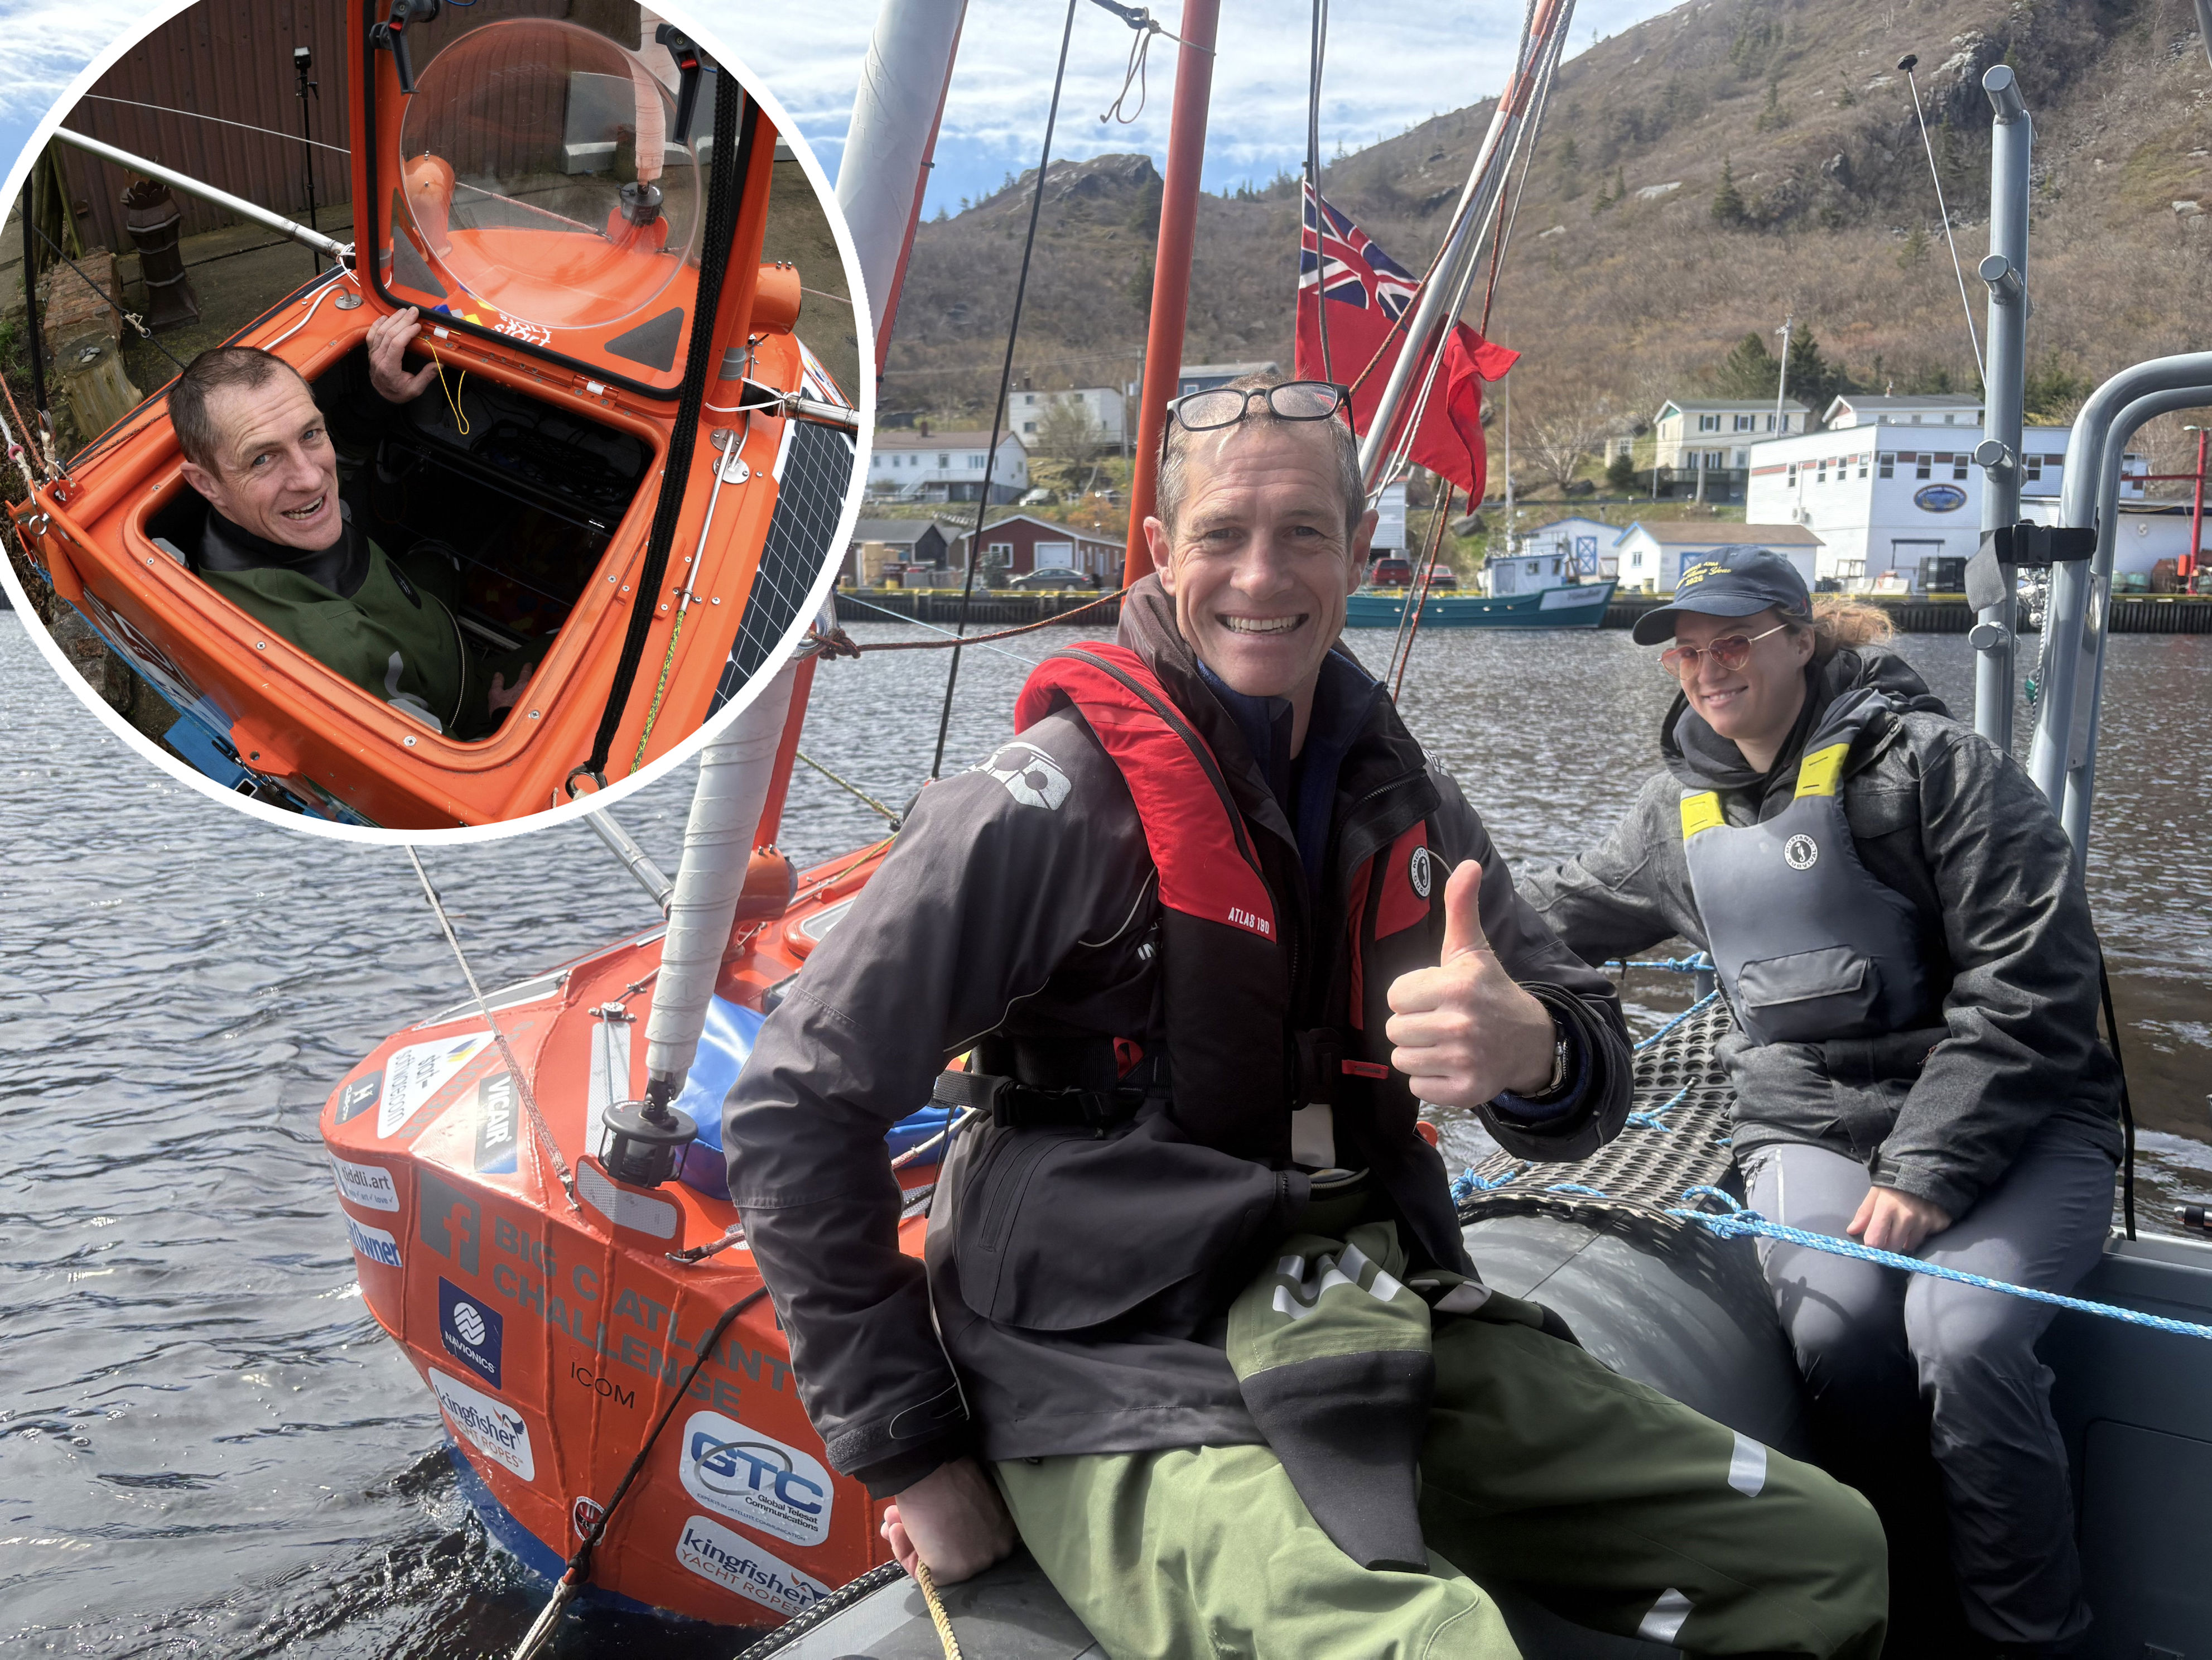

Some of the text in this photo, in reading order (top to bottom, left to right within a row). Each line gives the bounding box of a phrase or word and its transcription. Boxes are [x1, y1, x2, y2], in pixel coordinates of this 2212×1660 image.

[1786, 835, 1814, 853] MUSTANG
[1787, 849, 1816, 868] SURVIVAL
[1228, 907, 1255, 928] ATLAS
[341, 1166, 391, 1190] tiddli.art
[495, 1215, 801, 1399] BIG C ATLANT
[445, 1331, 495, 1374] NAVIONICS
[493, 1263, 741, 1418] CHALLENGE
[571, 1361, 634, 1409] ICOM
[435, 1384, 516, 1450] kingfisher
[691, 1432, 823, 1514] GTC
[697, 1493, 721, 1508] EXPERTS
[745, 1497, 819, 1532] Communications
[758, 1494, 818, 1524] Global Telesat
[681, 1548, 803, 1614] YACHT ROPES
[683, 1528, 812, 1606] kingfisher
